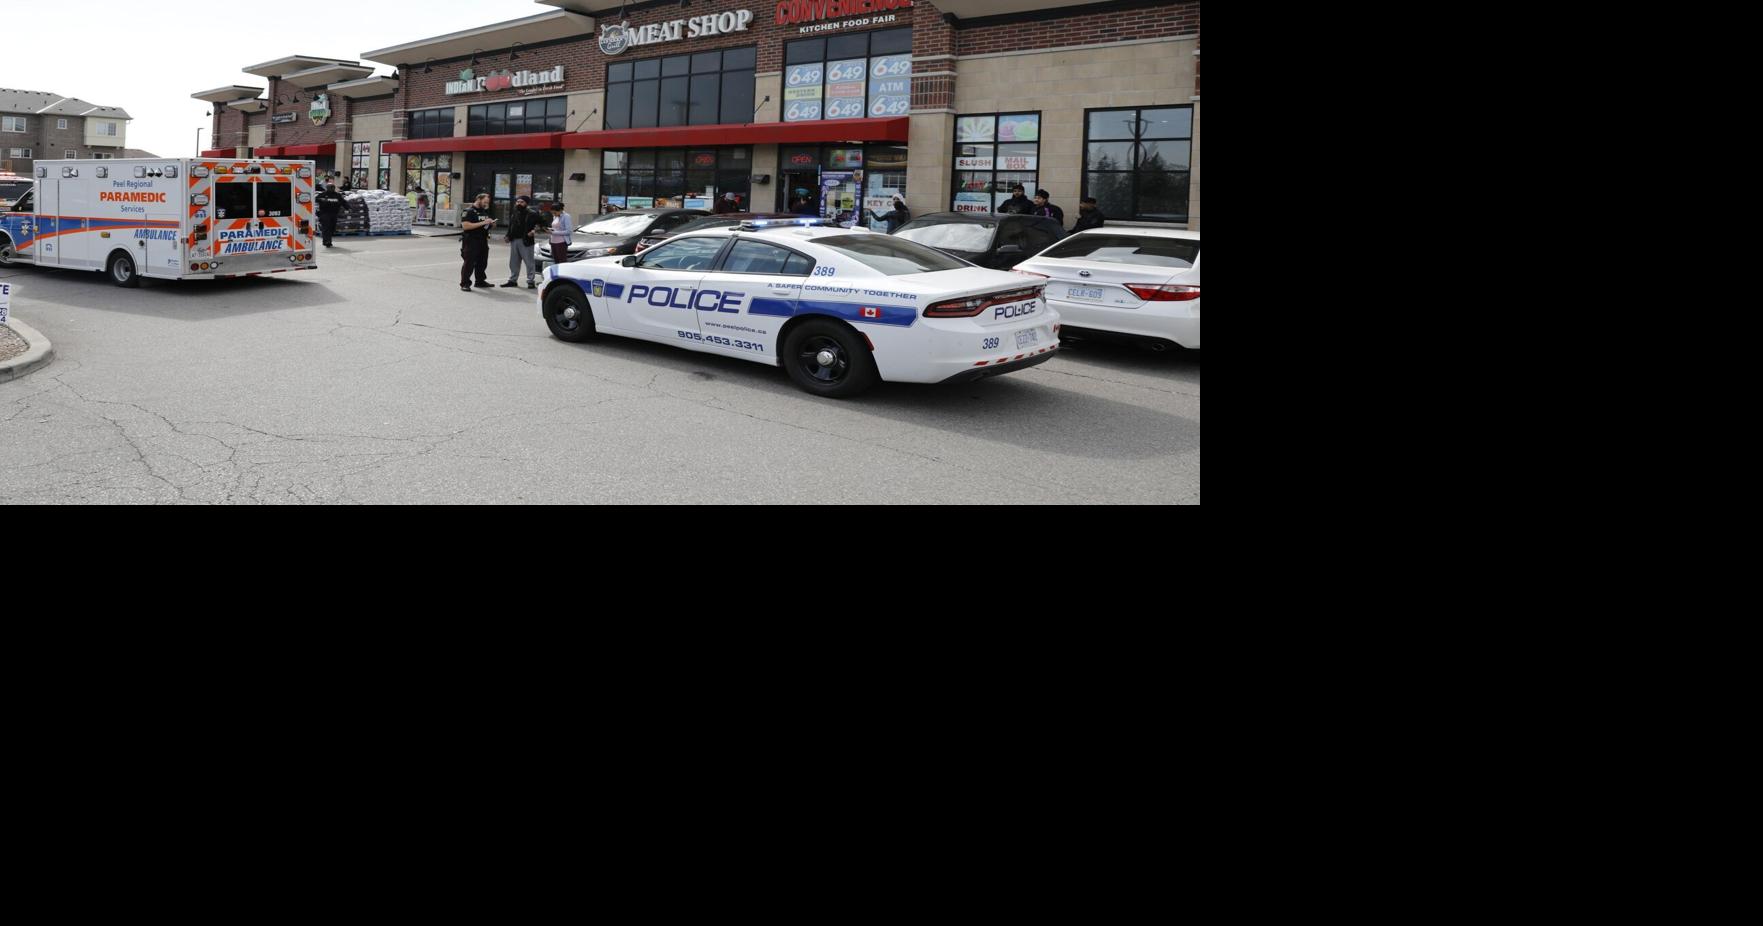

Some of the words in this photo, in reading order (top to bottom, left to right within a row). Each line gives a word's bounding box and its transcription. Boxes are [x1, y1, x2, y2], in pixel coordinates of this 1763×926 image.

[775, 0, 912, 25] CONVENIE
[628, 19, 687, 46] MEAT
[688, 9, 753, 38] SHOP
[799, 22, 840, 33] KITCHEN
[842, 18, 870, 28] FOOD
[872, 14, 896, 24] FAIR
[880, 82, 904, 92] ATM
[959, 159, 992, 167] SLUSH
[113, 180, 125, 188] Peel
[126, 180, 153, 189] Regional
[100, 191, 166, 203] PARAMEDIC
[120, 205, 145, 213] Services
[957, 204, 988, 212] DRINK
[134, 229, 177, 240] AMBULANCE
[220, 228, 288, 239] PARAMEDIC
[225, 240, 283, 254] AMBULANCE
[813, 266, 836, 277] 389
[627, 284, 746, 314] POLICE
[804, 285, 861, 294] COMMUNITY
[863, 289, 917, 300] TOGETHER
[994, 301, 1037, 320] POLICE
[705, 321, 767, 335] www.peelpolice.ca
[677, 330, 764, 352] 905.453.3311
[982, 337, 1000, 350] 389
